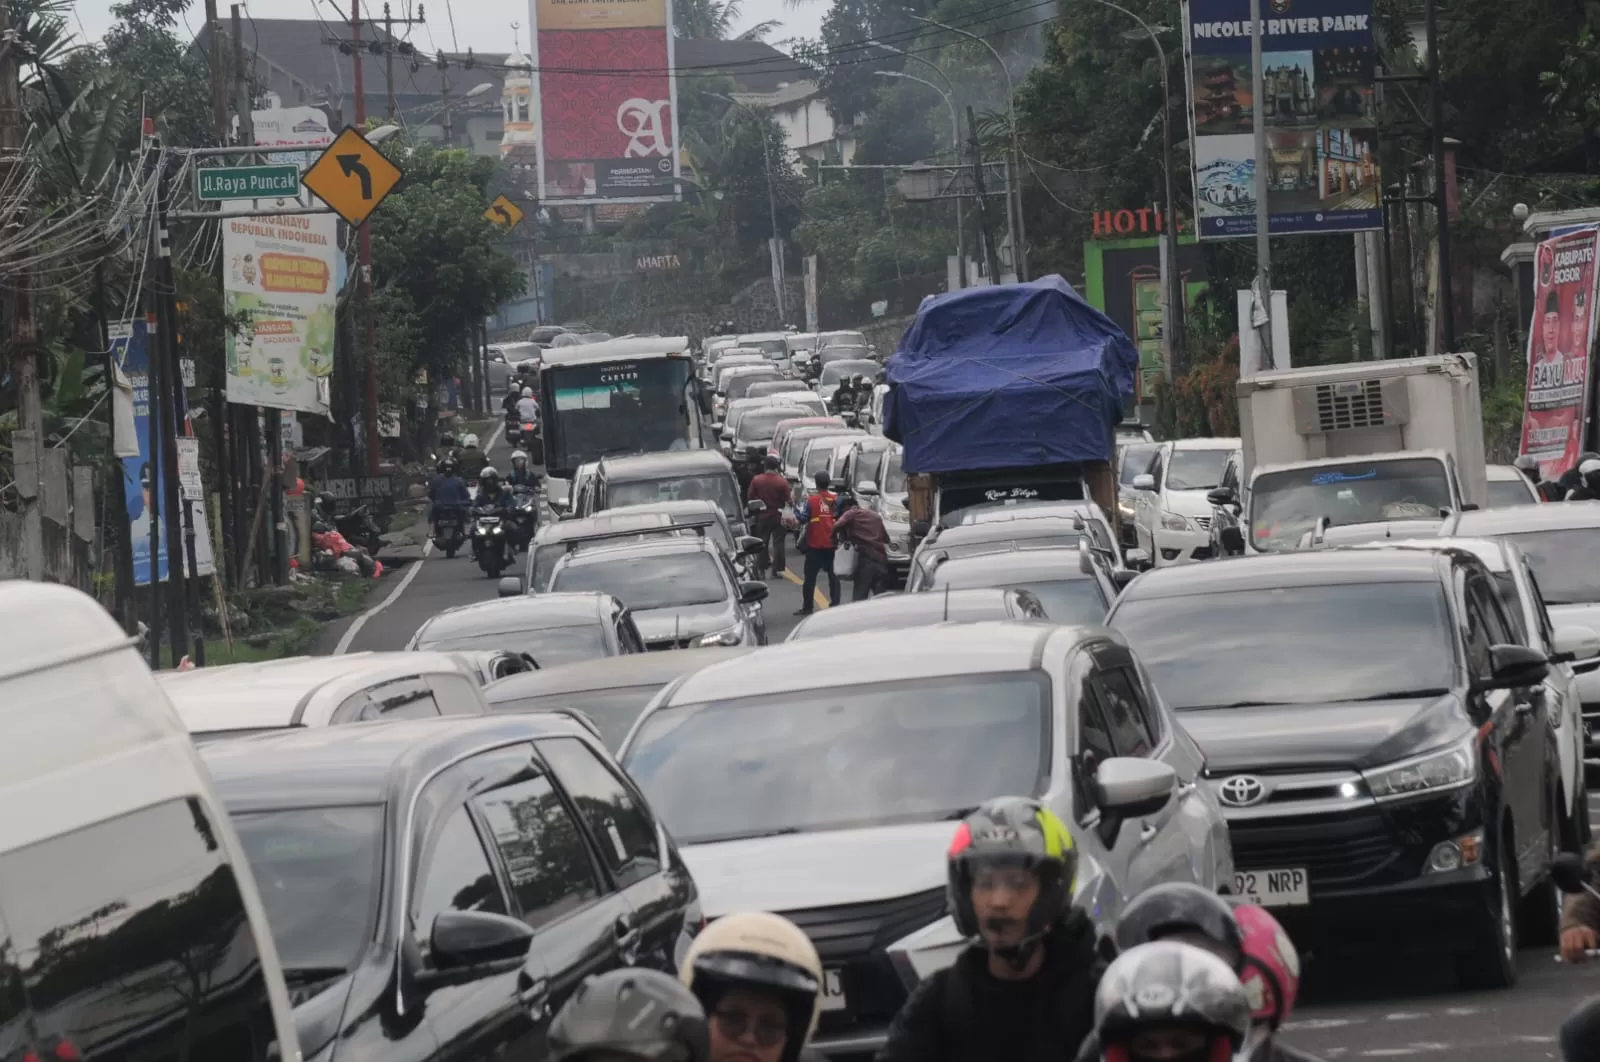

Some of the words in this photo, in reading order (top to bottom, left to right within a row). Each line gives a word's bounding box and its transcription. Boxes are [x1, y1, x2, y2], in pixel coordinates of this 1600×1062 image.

[1267, 18, 1319, 35] RIVER
[1321, 14, 1368, 32] PARK
[250, 172, 295, 189] Puncak
[230, 221, 276, 238] REPUBLIK
[278, 229, 328, 246] INDONESIA
[1554, 267, 1580, 285] BOGOR
[1532, 362, 1563, 390] BAYU
[1267, 871, 1304, 893] NRP
